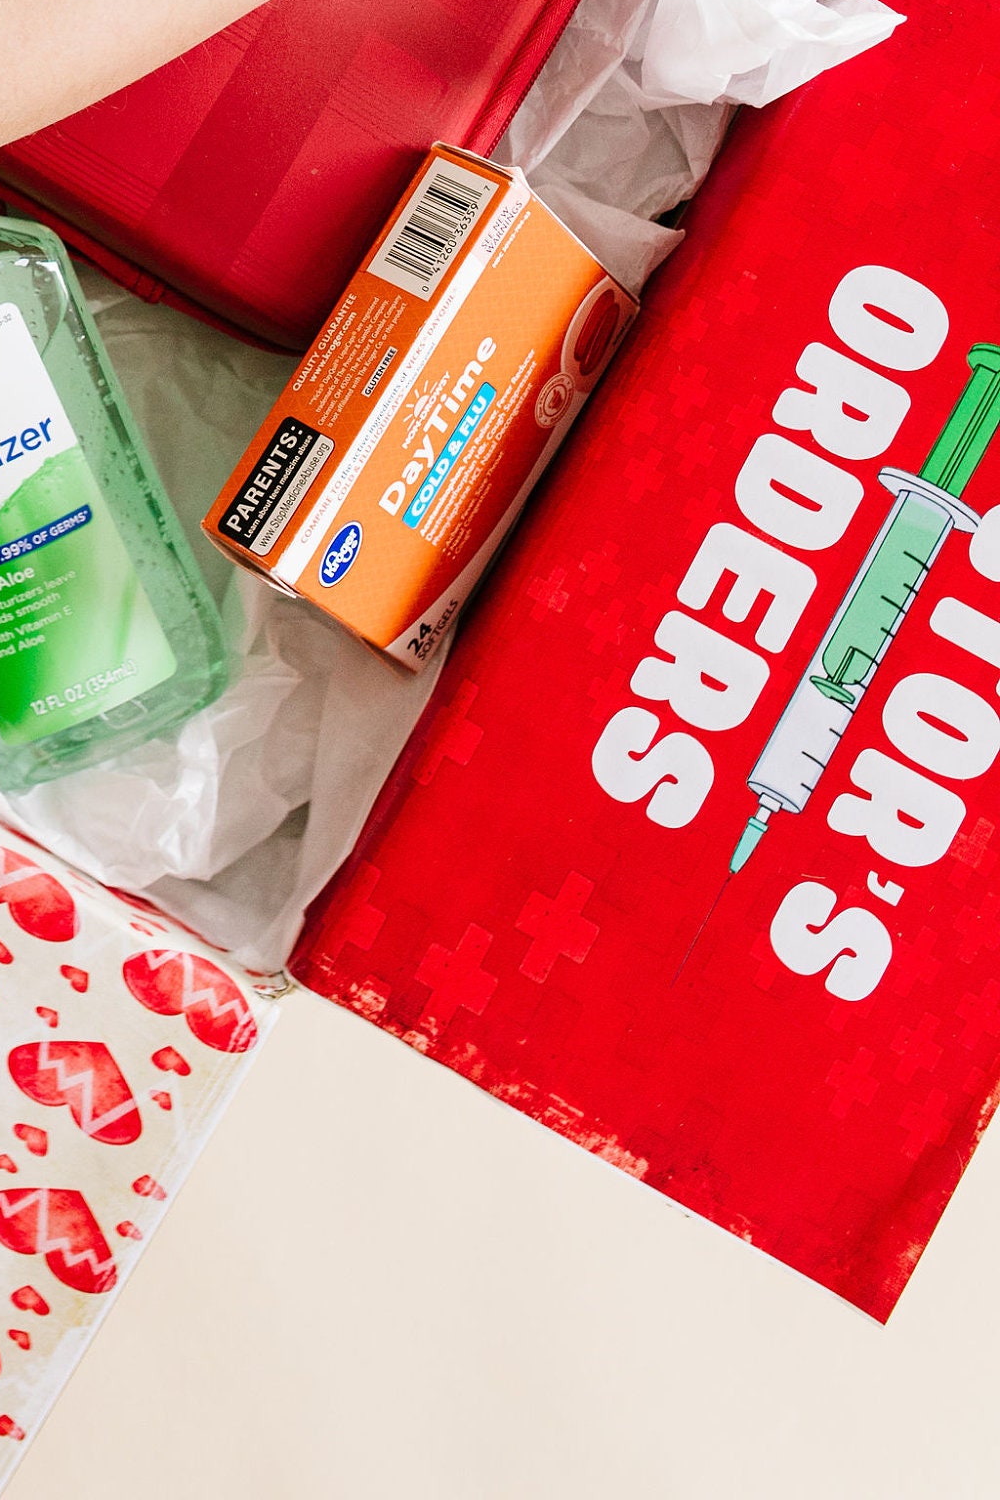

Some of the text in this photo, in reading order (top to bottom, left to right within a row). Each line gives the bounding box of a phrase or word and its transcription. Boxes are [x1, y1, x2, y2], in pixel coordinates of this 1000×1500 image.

[431, 238, 457, 273] 41260
[454, 201, 480, 236] 36359
[480, 205, 510, 248] SEE NEW
[485, 200, 523, 254] WARNINGS
[291, 292, 357, 391] QUALITY GUARANTEE
[307, 309, 358, 384] www.kroger.com
[333, 388, 343, 399] OH
[350, 361, 360, 372] The
[356, 342, 372, 363] Procter
[371, 317, 387, 339] Gamble
[383, 294, 402, 319] Company
[355, 321, 364, 332] are
[360, 296, 380, 323] registered
[314, 383, 336, 413] trademarks
[332, 376, 340, 384] of
[336, 366, 346, 377] The
[342, 347, 358, 368] Procter
[357, 322, 373, 344] Gamble
[329, 411, 339, 423] not
[335, 388, 354, 412] affiliated
[350, 375, 361, 389] with
[357, 365, 368, 377] The
[364, 348, 379, 367] Kroger
[380, 332, 388, 341] or
[384, 322, 395, 334] this
[363, 348, 396, 395] GLUTEN FREE
[485, 411, 506, 441] Cough
[502, 359, 538, 412] Suppressant
[376, 334, 500, 516] DayTime
[400, 370, 452, 449] NON-DROWSY
[462, 444, 477, 464] Pain
[495, 383, 514, 408] Fever
[510, 347, 536, 385] Reducer
[479, 440, 498, 465] Nasal
[494, 381, 534, 441] Decongestant
[226, 422, 303, 533] PARENTS:
[244, 433, 313, 539] Learn about teen medicine abuse
[299, 495, 333, 544] COMPARE
[329, 478, 343, 495] TO
[338, 460, 353, 479] the
[348, 432, 370, 463] active
[366, 381, 403, 435] ingredients
[397, 370, 409, 383] of
[335, 472, 357, 502] COLD
[358, 444, 374, 464] FLU
[408, 394, 488, 518] COLD & FLU
[257, 441, 330, 548] www.StopMedicineAbuse.org
[31, 530, 49, 545] OF
[323, 528, 359, 578] Kroger
[591, 264, 950, 828] ORDERS
[14, 590, 61, 618] smooth
[43, 568, 77, 590] leave
[14, 608, 63, 637] Vitamin
[62, 604, 73, 617] E
[16, 631, 45, 652] Aloe
[406, 620, 433, 655] 24
[416, 597, 459, 661] SOFTGELS
[29, 698, 48, 717] 12
[44, 691, 65, 711] FL
[62, 682, 86, 704] OZ
